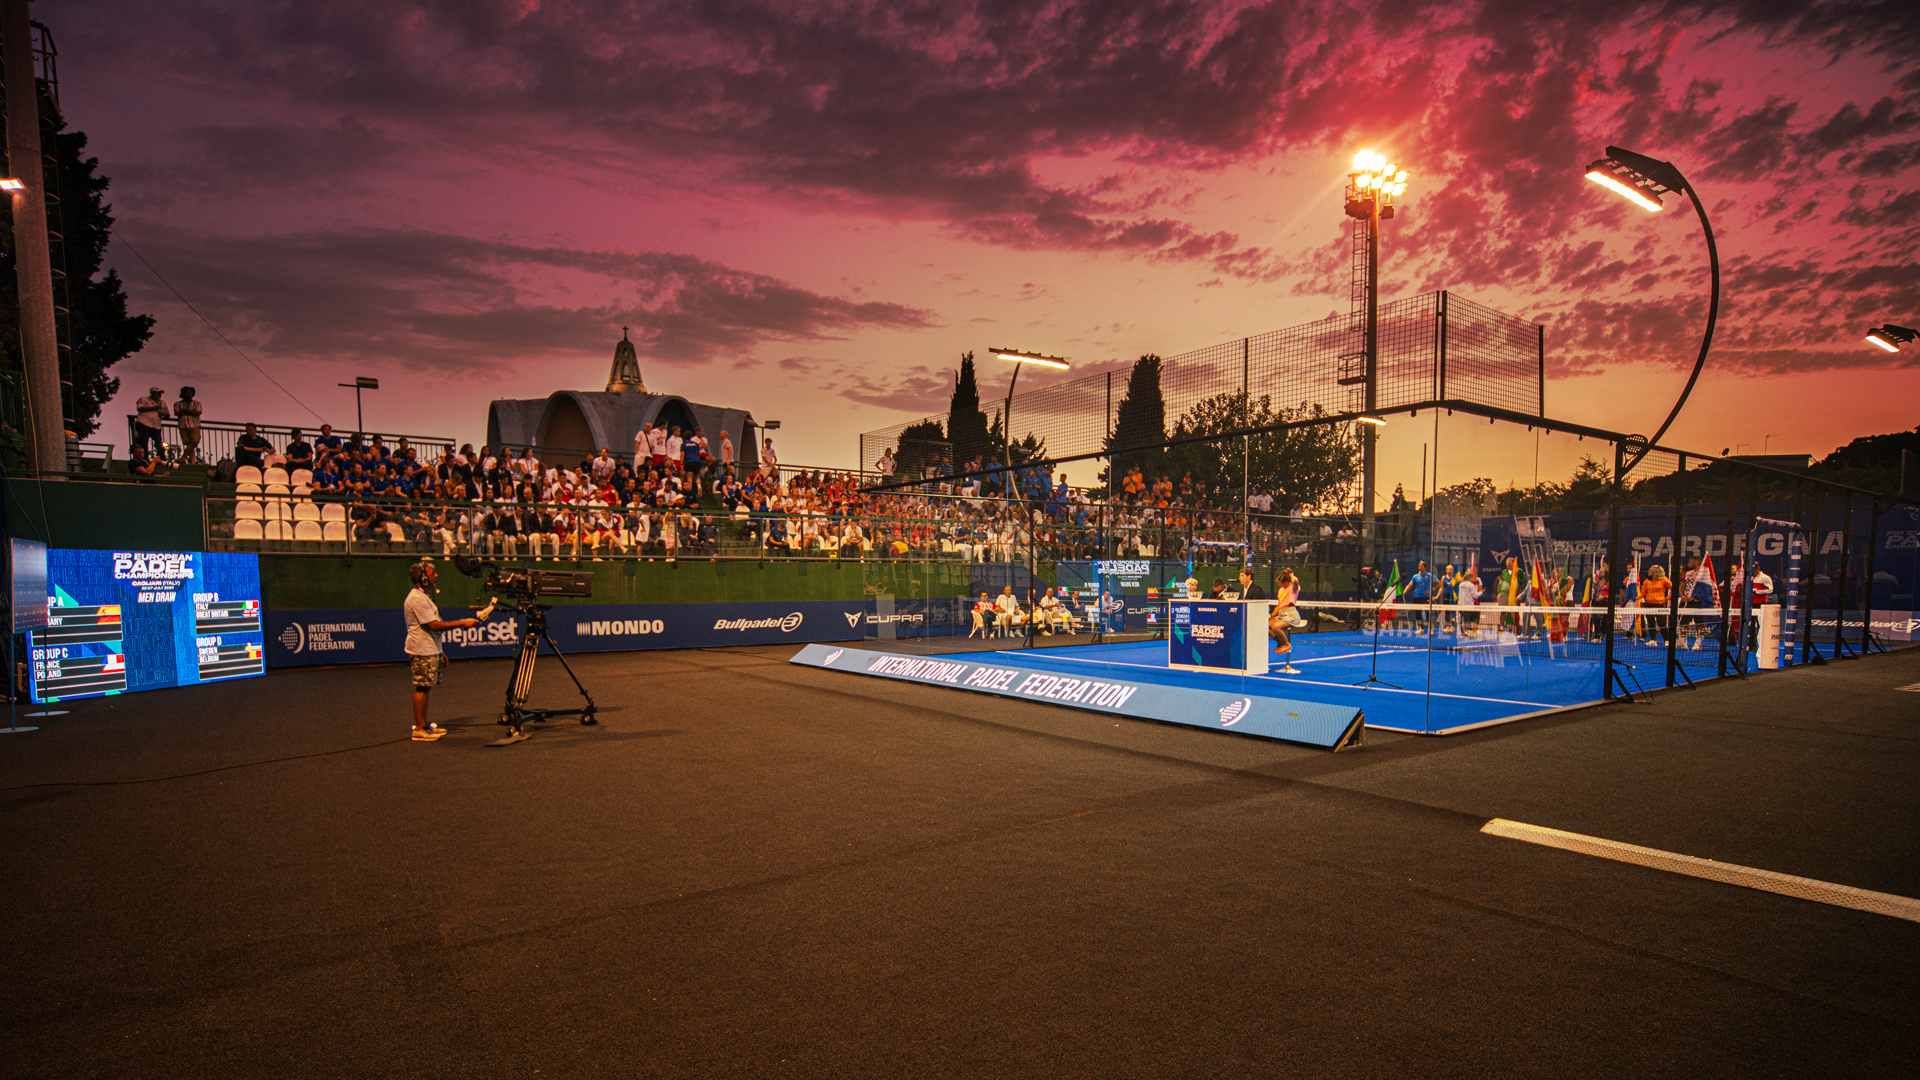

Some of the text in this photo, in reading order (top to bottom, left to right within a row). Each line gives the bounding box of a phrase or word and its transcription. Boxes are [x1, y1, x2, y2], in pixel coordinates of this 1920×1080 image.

[1631, 531, 1850, 557] SARDEGNA
[113, 552, 132, 560] FIP
[133, 552, 193, 561] EUROPEAN
[114, 560, 194, 573] PADEL
[58, 596, 64, 607] A
[138, 591, 177, 603] MEN DRAW
[193, 592, 219, 603] GROUP B
[713, 617, 783, 631] Bullpadel
[867, 613, 923, 624] CUPRA
[308, 623, 366, 633] INTERNATIONAL
[592, 619, 664, 636] MONDO
[1191, 628, 1223, 636] PADEL
[196, 636, 222, 647] GROUP D
[308, 633, 333, 642] PADEL
[198, 647, 218, 655] SWEDEN
[309, 640, 355, 651] FEDERATION
[61, 647, 68, 658] C
[199, 654, 220, 663] BELGIUM
[35, 660, 61, 669] FRNCE
[868, 655, 968, 683] INTERNATIONAL
[963, 667, 1019, 691] PADEL
[1015, 673, 1137, 709] FEDERATION
